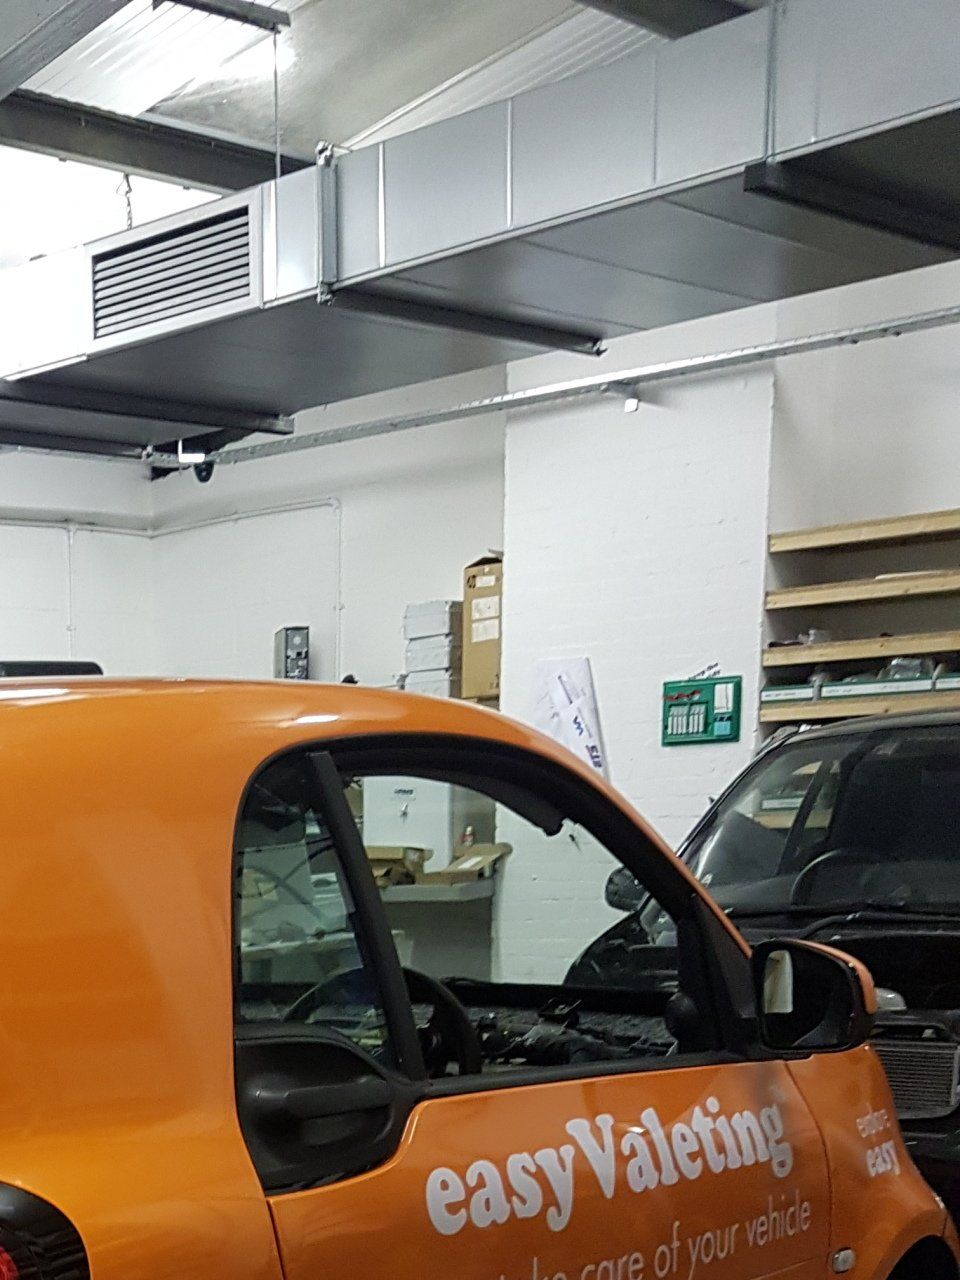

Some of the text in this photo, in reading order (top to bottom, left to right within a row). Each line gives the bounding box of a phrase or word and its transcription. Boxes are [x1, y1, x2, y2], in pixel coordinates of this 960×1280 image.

[426, 1096, 793, 1235] easyValeting
[654, 1221, 682, 1279] of
[744, 1189, 812, 1248] vehicle
